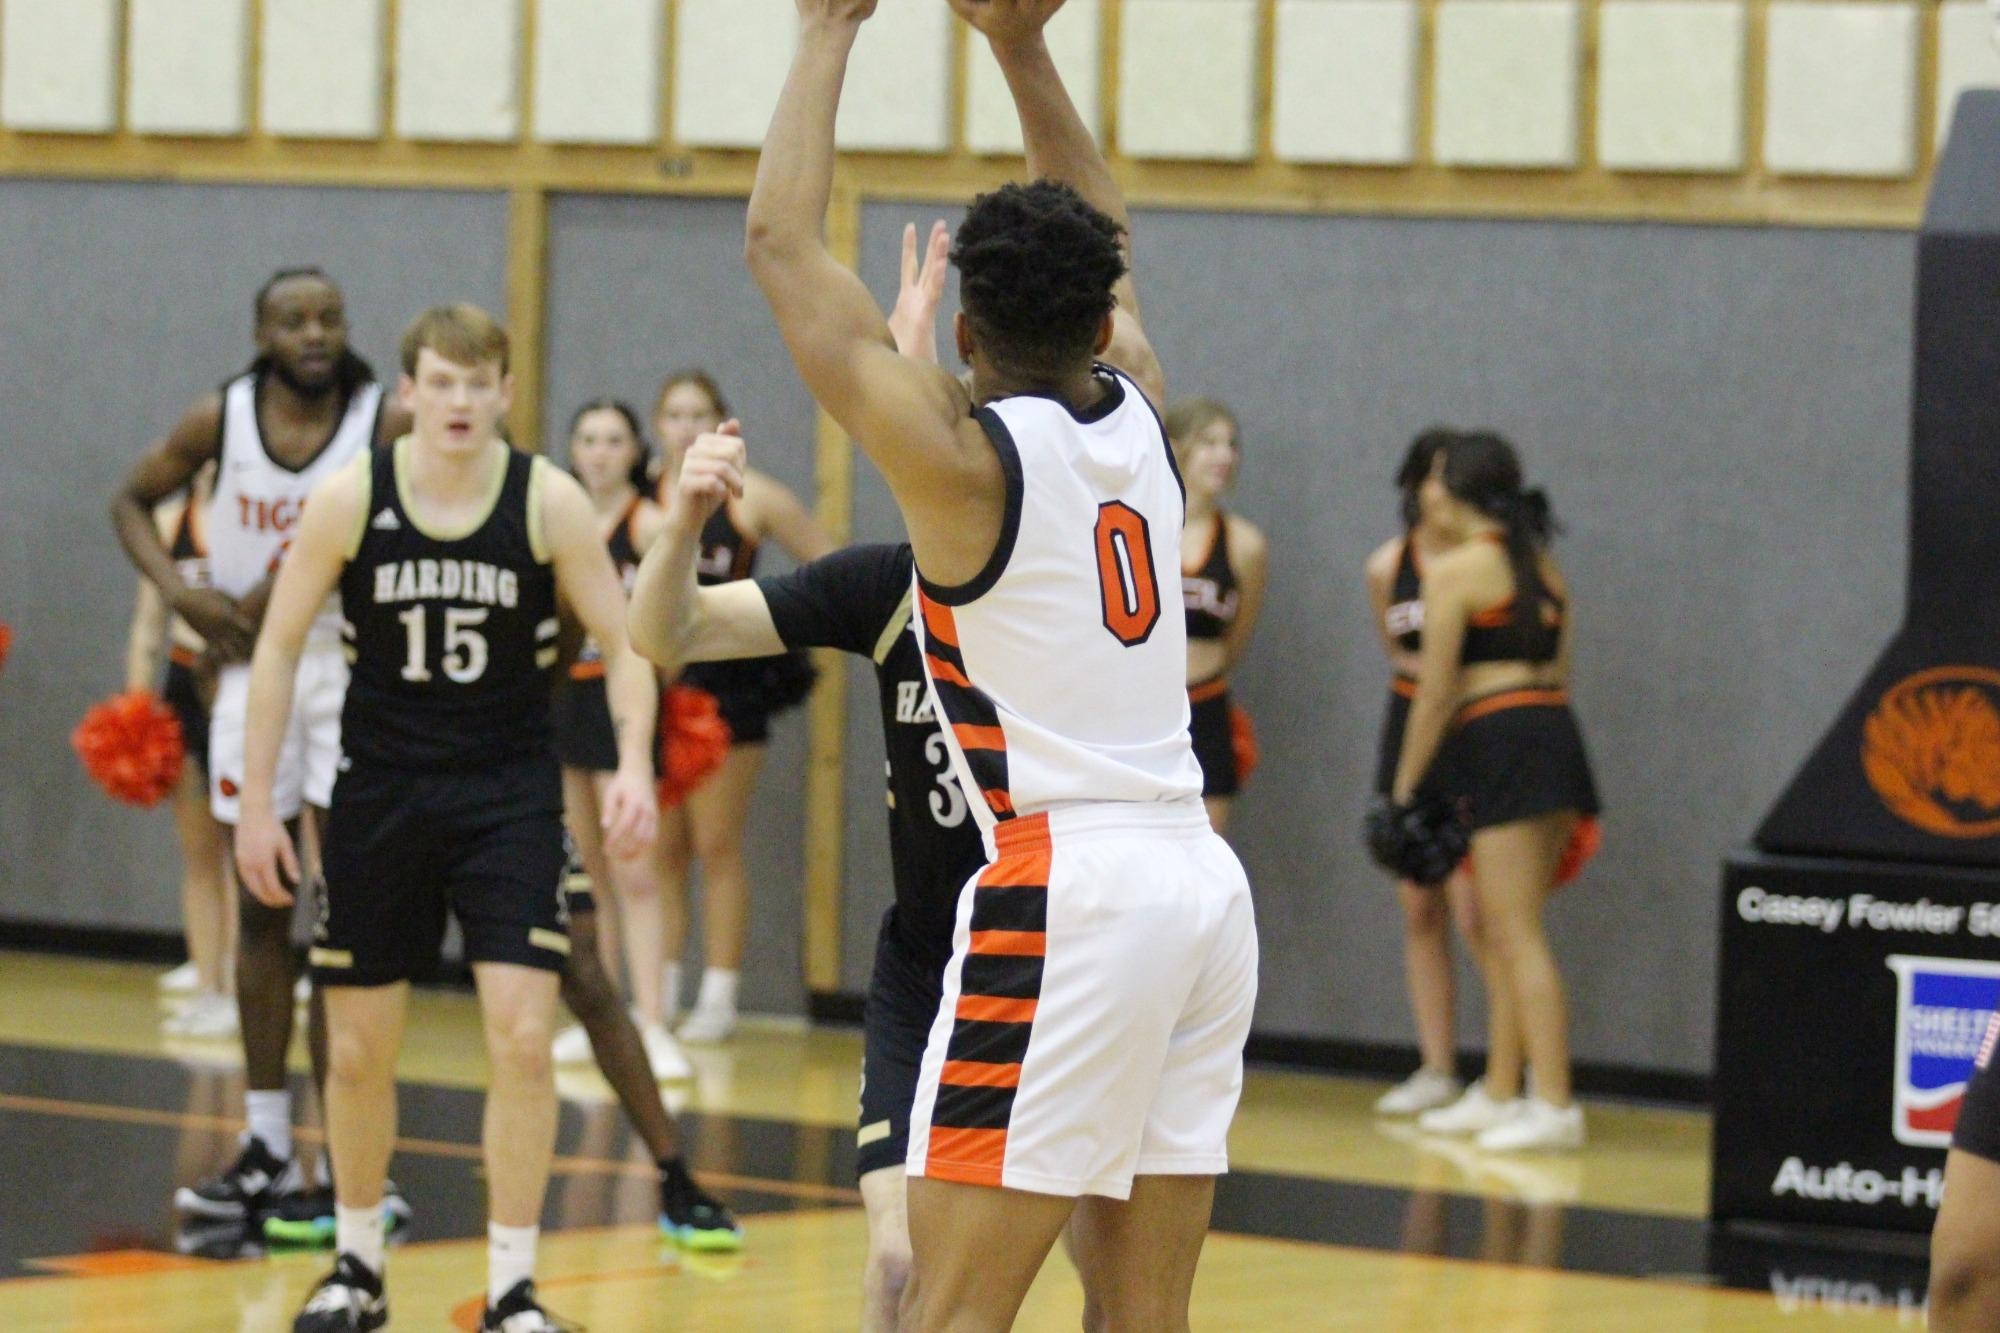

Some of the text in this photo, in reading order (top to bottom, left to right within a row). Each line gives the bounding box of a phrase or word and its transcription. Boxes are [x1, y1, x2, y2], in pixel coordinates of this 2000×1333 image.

[374, 559, 518, 607] HARDING
[1094, 499, 1161, 647] 0
[399, 604, 489, 683] 15
[925, 732, 967, 828] 3
[1737, 886, 1844, 933] Casey
[1849, 893, 1964, 935] Fowler
[1771, 1156, 1945, 1209] Auto-H
